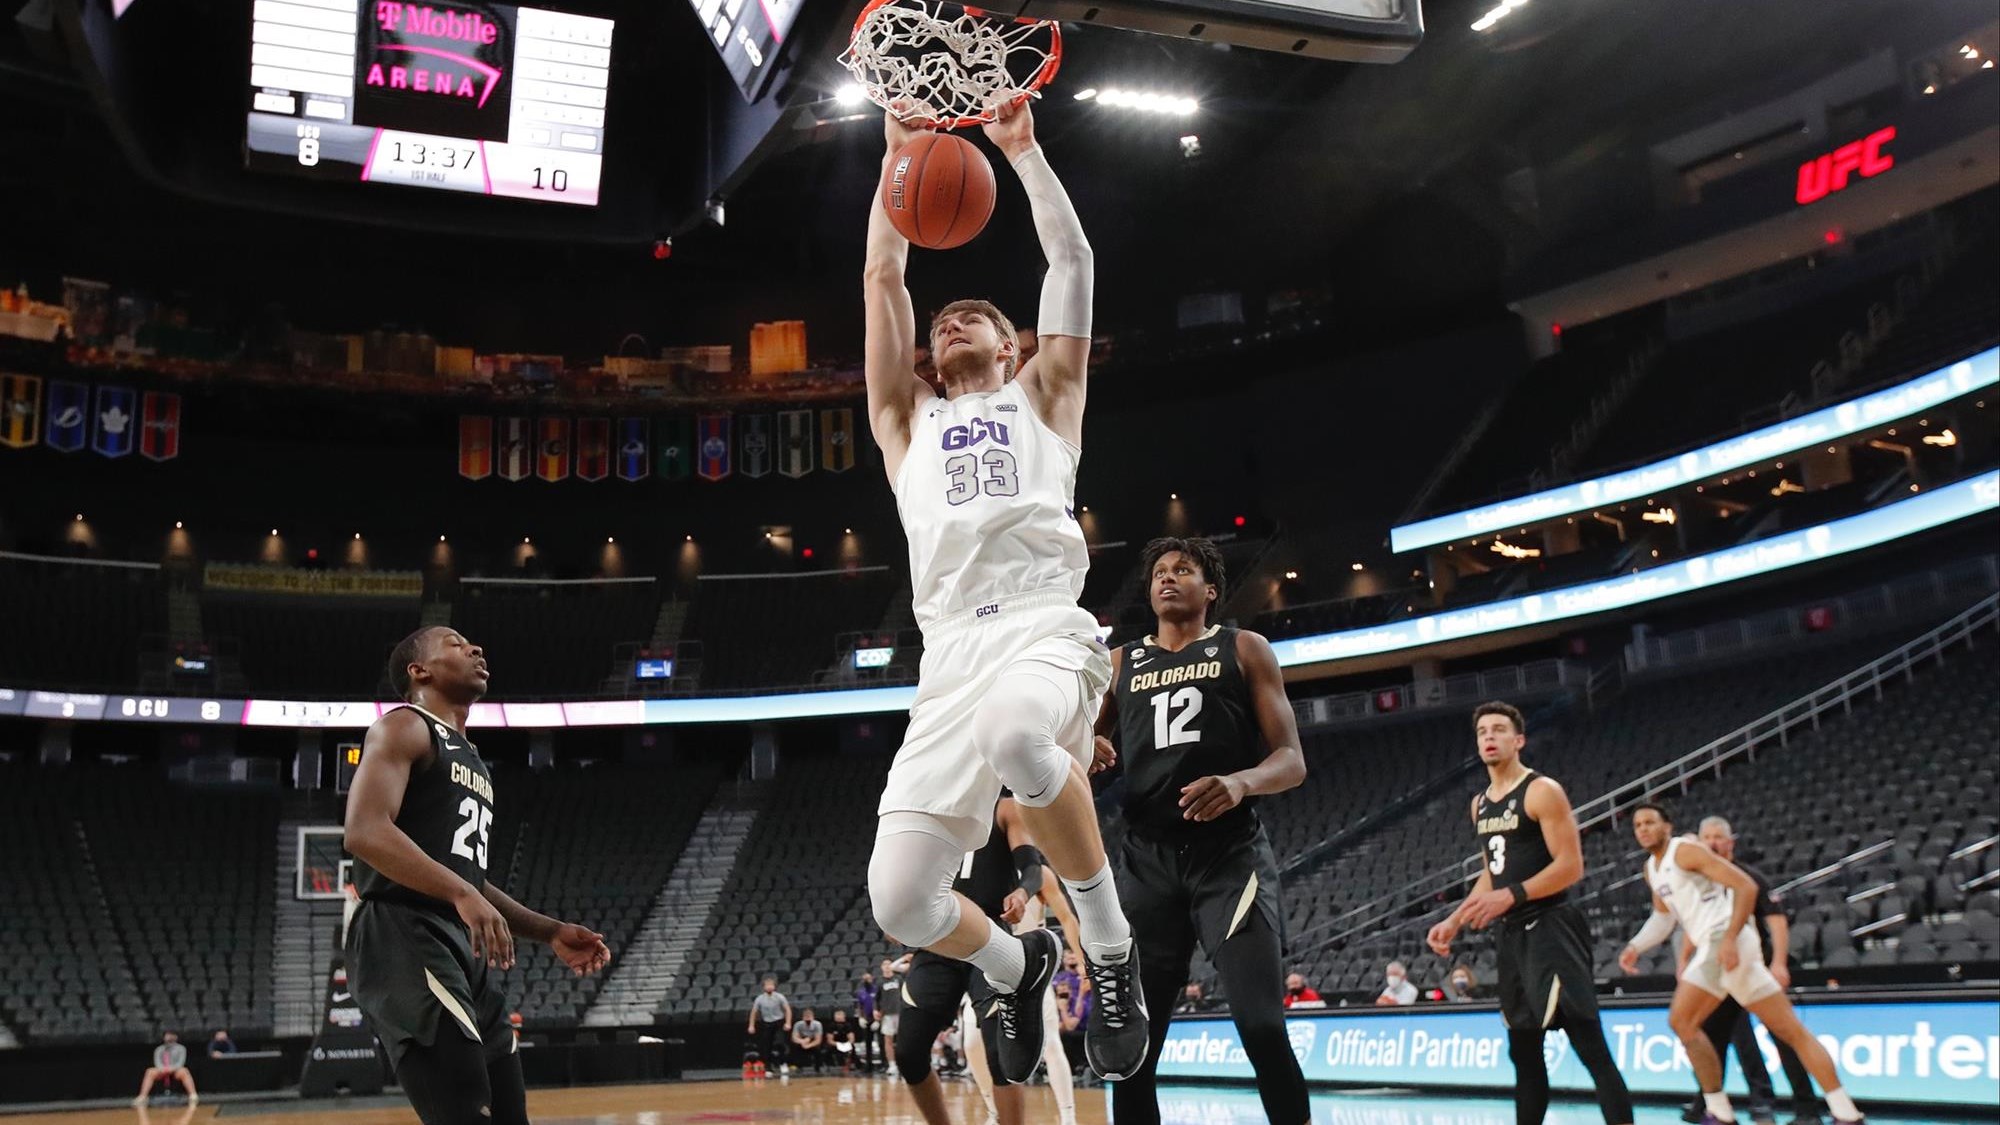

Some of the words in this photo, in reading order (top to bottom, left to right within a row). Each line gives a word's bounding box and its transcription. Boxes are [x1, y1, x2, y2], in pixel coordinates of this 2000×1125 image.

[406, 6, 497, 44] Mobile
[367, 63, 475, 98] ARENA
[298, 139, 319, 167] 8
[393, 141, 476, 170] 13:37
[1796, 125, 1897, 205] UFC
[532, 167, 568, 192] 10
[941, 417, 1010, 451] GCU
[945, 449, 1019, 506] 33
[976, 604, 999, 618] GCU
[1130, 661, 1221, 692] COLORADO
[201, 701, 220, 720] 8
[1150, 686, 1203, 750] 12
[451, 796, 493, 870] 25
[1488, 834, 1505, 875] 3
[1326, 1028, 1405, 1067] Official
[1409, 1030, 1504, 1069] Partner
